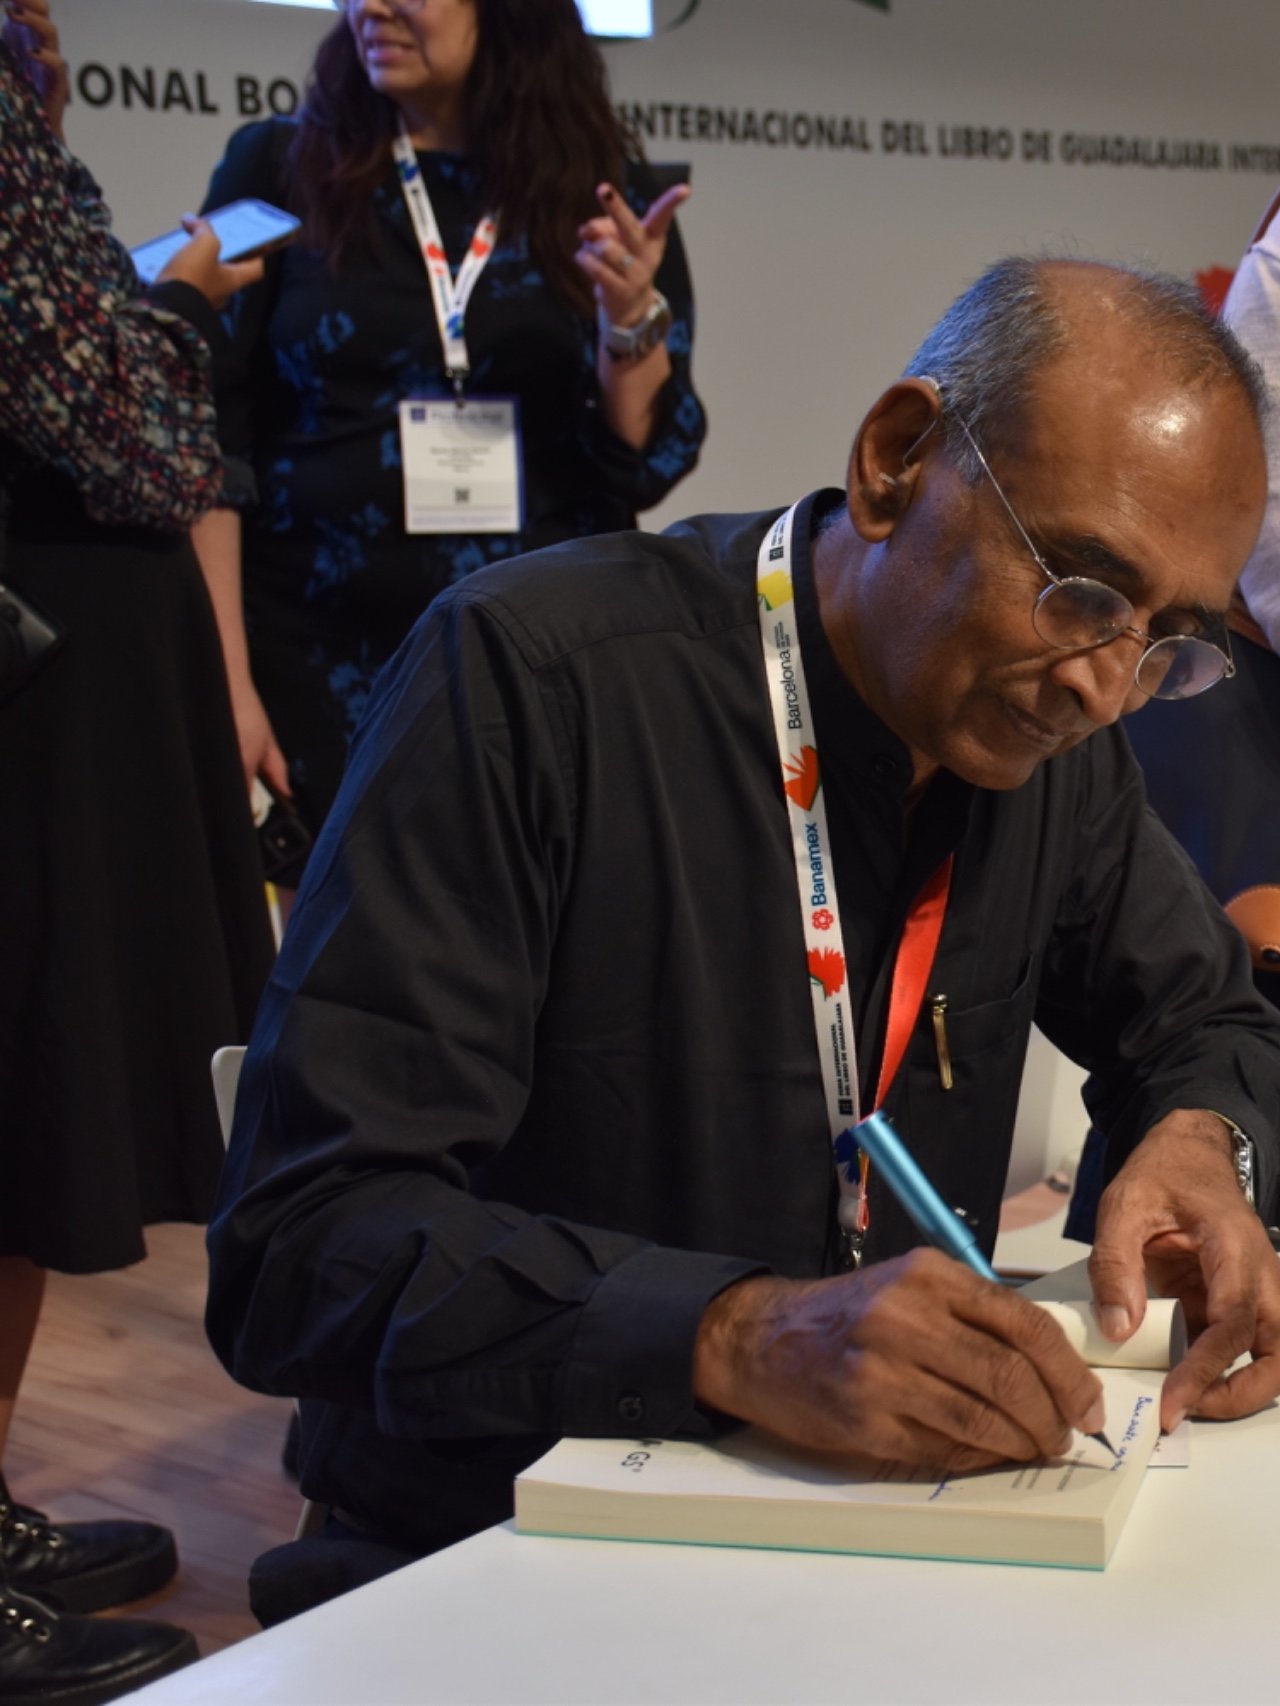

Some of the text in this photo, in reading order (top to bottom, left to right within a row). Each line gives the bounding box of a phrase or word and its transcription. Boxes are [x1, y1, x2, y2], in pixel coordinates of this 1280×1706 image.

[66, 61, 220, 114] ONAL
[621, 99, 871, 152] INTERNACIONAL
[881, 118, 930, 156] DEL
[938, 124, 1014, 162] LIBRO
[1021, 129, 1053, 164] DE
[1059, 131, 1222, 171] GUADALAJARA
[779, 649, 803, 730] Barcelona
[805, 822, 827, 907] Banamex
